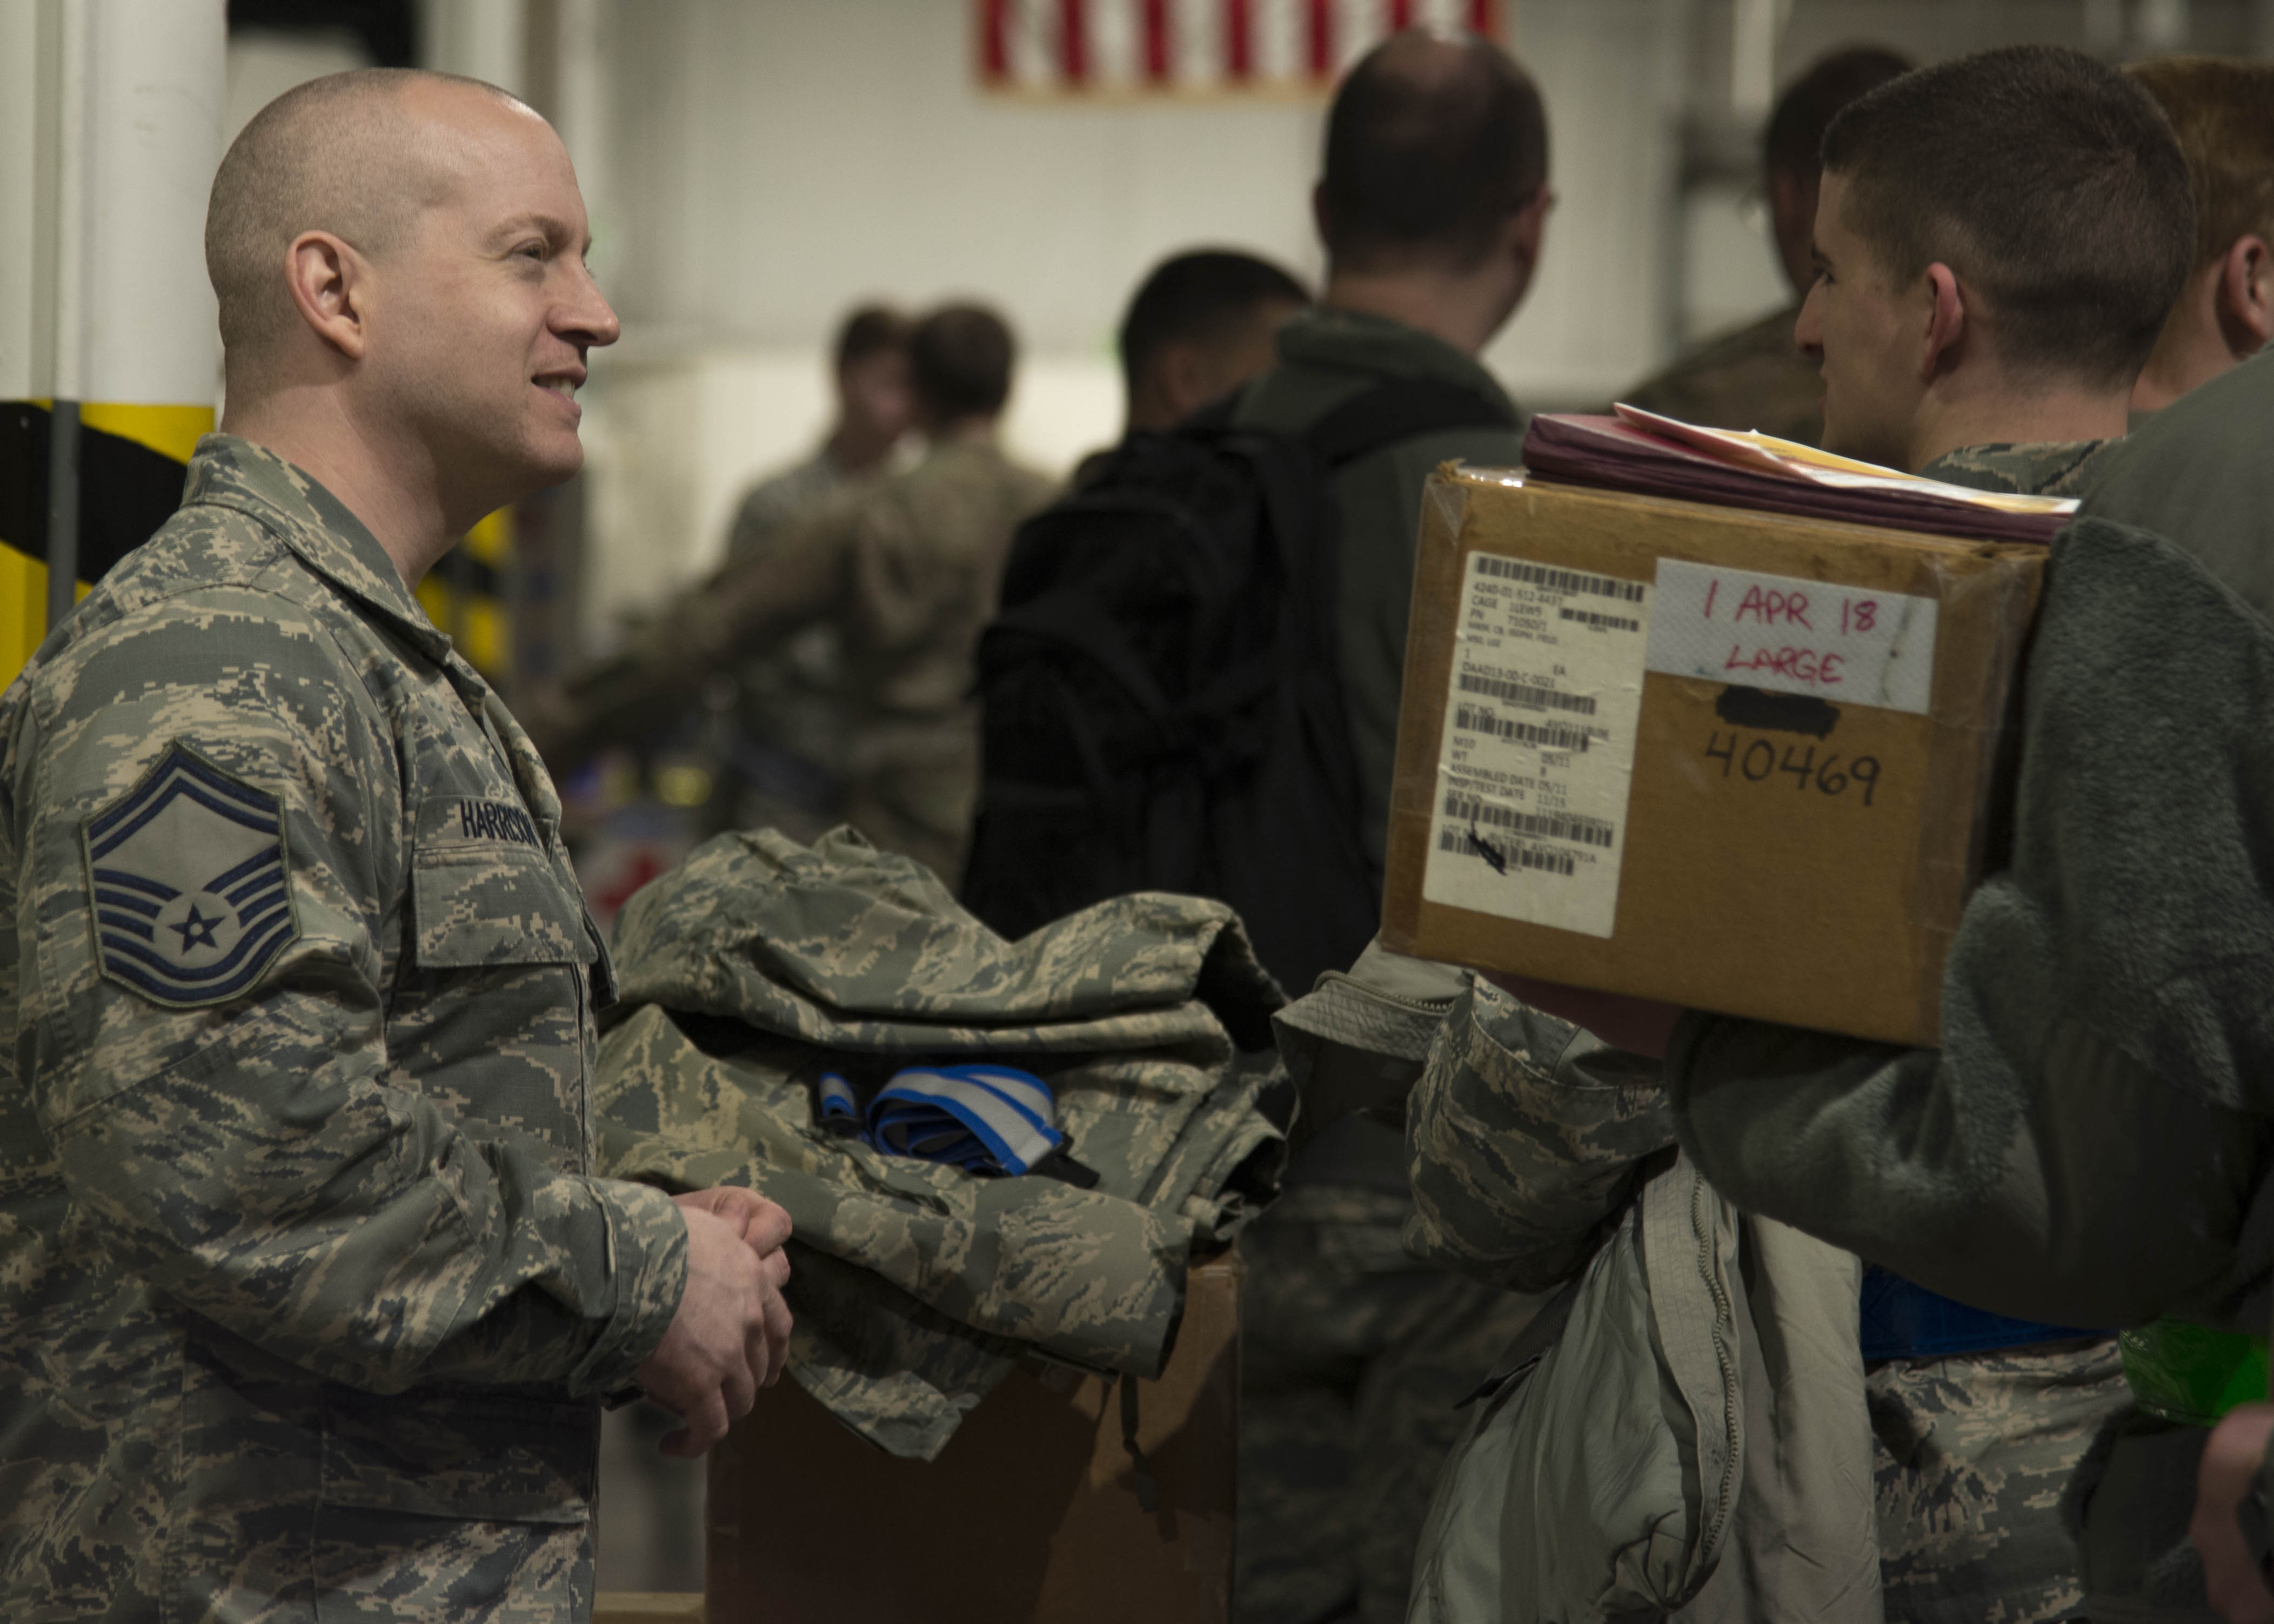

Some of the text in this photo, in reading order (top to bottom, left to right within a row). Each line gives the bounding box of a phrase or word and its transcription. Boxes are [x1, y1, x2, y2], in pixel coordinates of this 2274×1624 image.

[1469, 608, 1484, 620] PN
[1471, 595, 1497, 609] CAGE
[1704, 580, 1878, 635] 1 APR 18
[1553, 665, 1567, 677] EA
[1725, 645, 1844, 686] LARGE
[1450, 763, 1508, 783] ASSEMBLED
[1509, 775, 1536, 789] DATE
[1706, 731, 1881, 807] 40469
[1499, 786, 1524, 800] DATE
[459, 800, 539, 847] HARRISON
